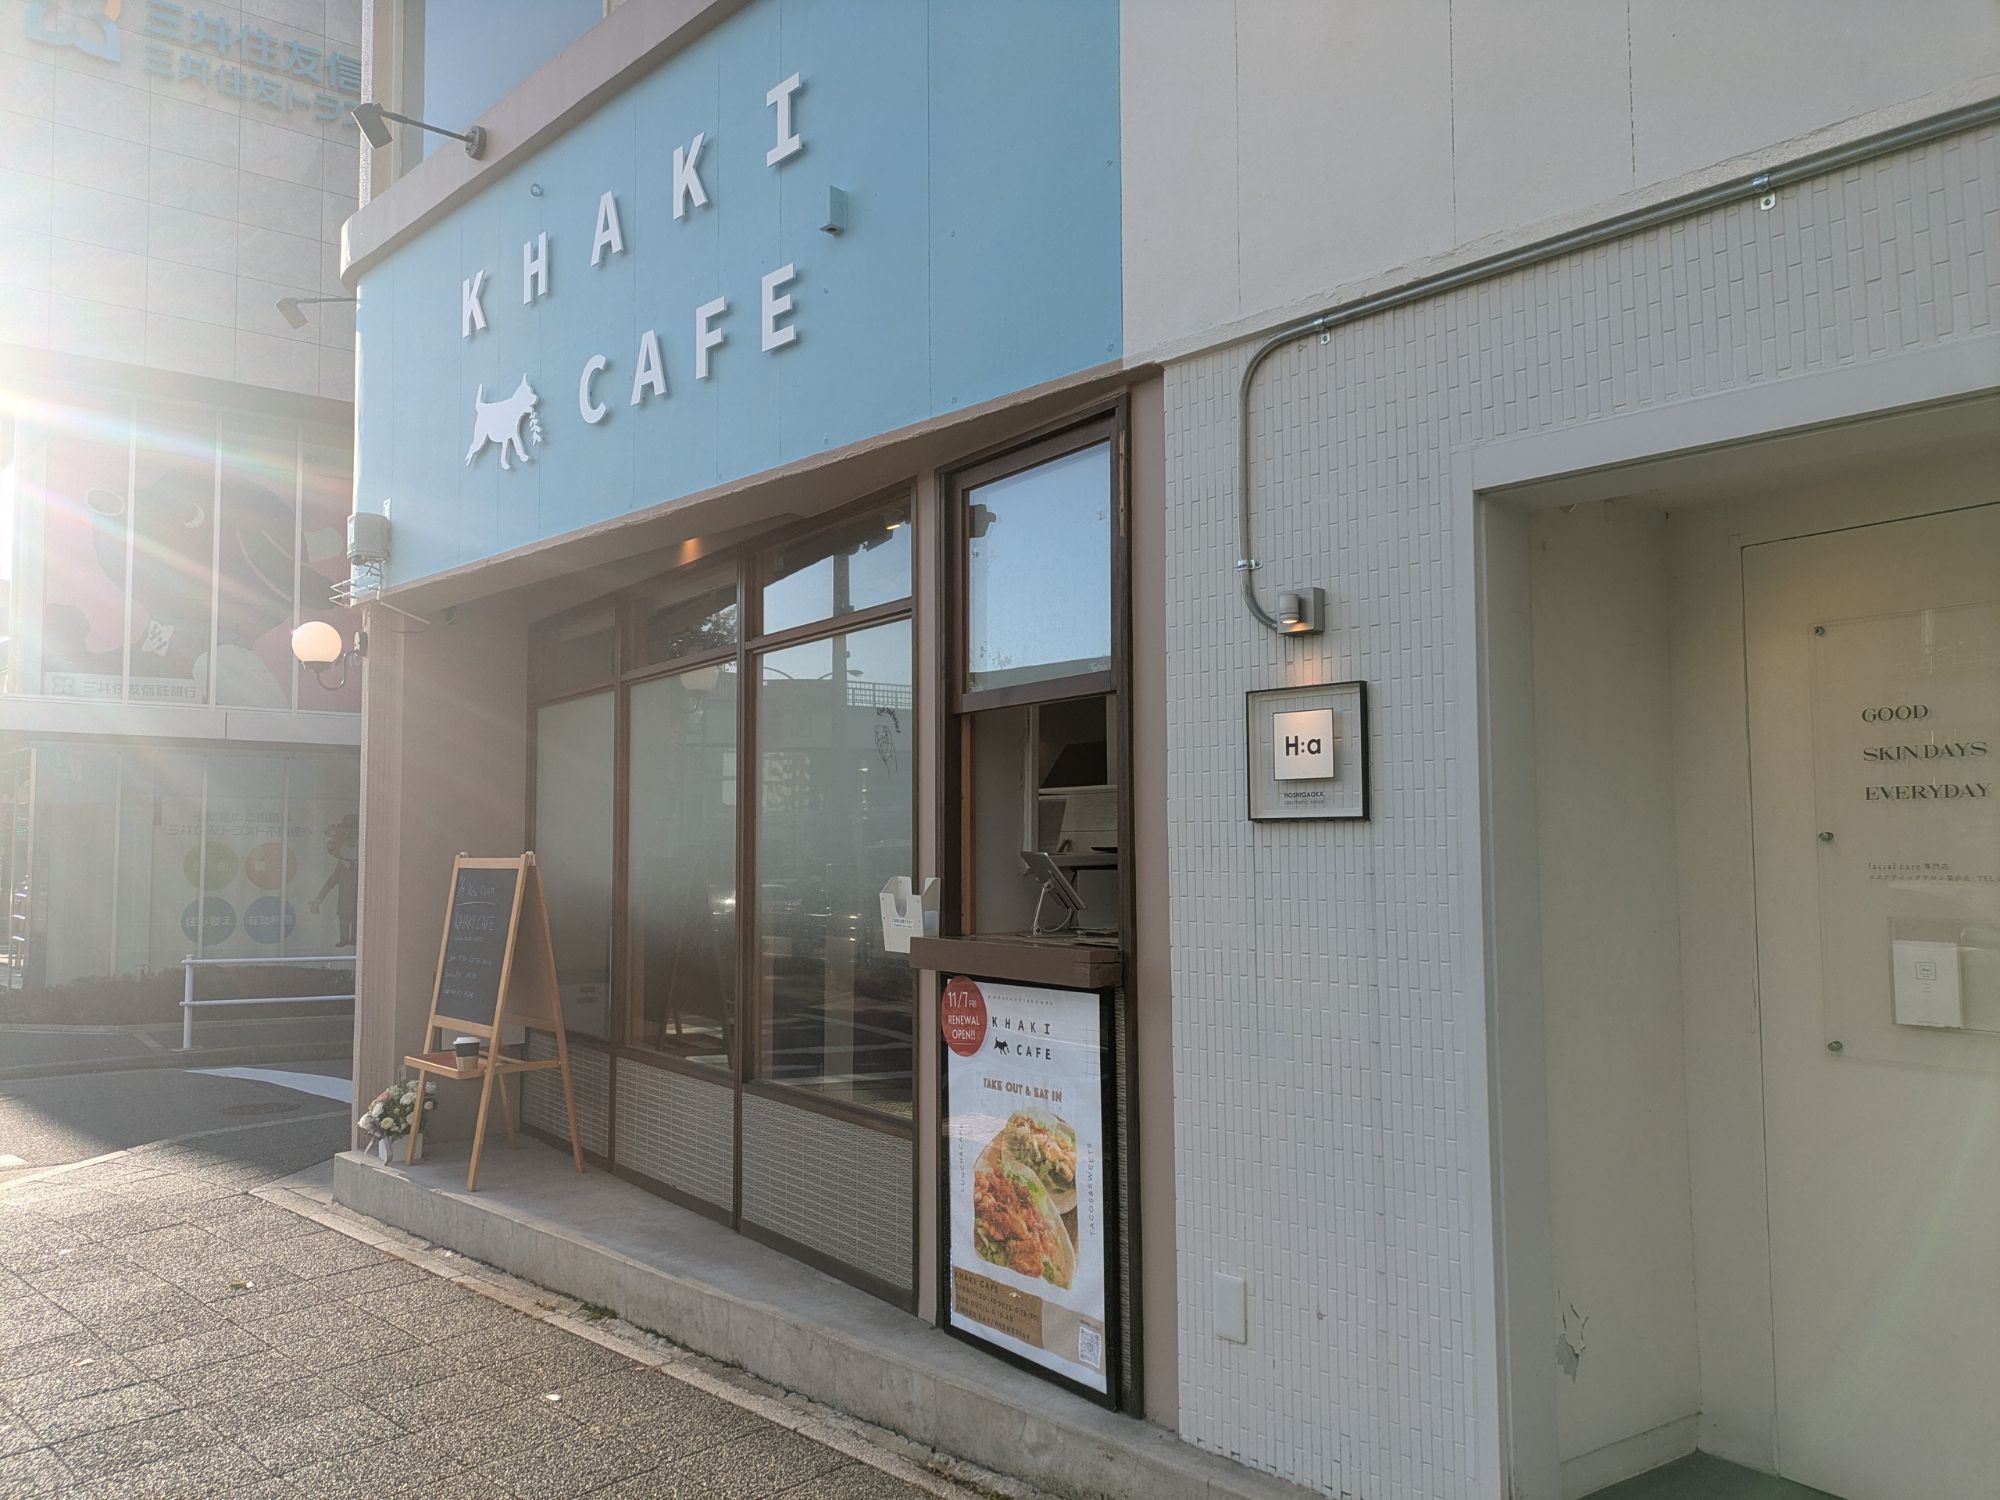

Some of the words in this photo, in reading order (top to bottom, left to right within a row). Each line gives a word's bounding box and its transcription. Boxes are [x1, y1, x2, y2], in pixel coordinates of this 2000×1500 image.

[462, 72, 801, 338] KHAKI
[579, 263, 797, 424] CAFE
[1862, 704, 1929, 723] GOOD
[1285, 735, 1321, 757] H:a
[1864, 745, 1919, 761] SKIN
[1925, 741, 1988, 759] DAYS
[1284, 791, 1324, 799] HOSHIGAOKA
[1865, 783, 1991, 801] EVERYDAY
[948, 991, 968, 1009] 11/7
[948, 1015, 980, 1026] RENEWAL
[992, 1016, 1050, 1035] KHAKI
[1016, 1044, 1052, 1060] CAFE
[983, 1077, 1002, 1091] TAKE
[1006, 1081, 1023, 1095] OUT
[1025, 1085, 1032, 1096] &
[1034, 1087, 1049, 1100] EAT
[1052, 1090, 1062, 1102] IN
